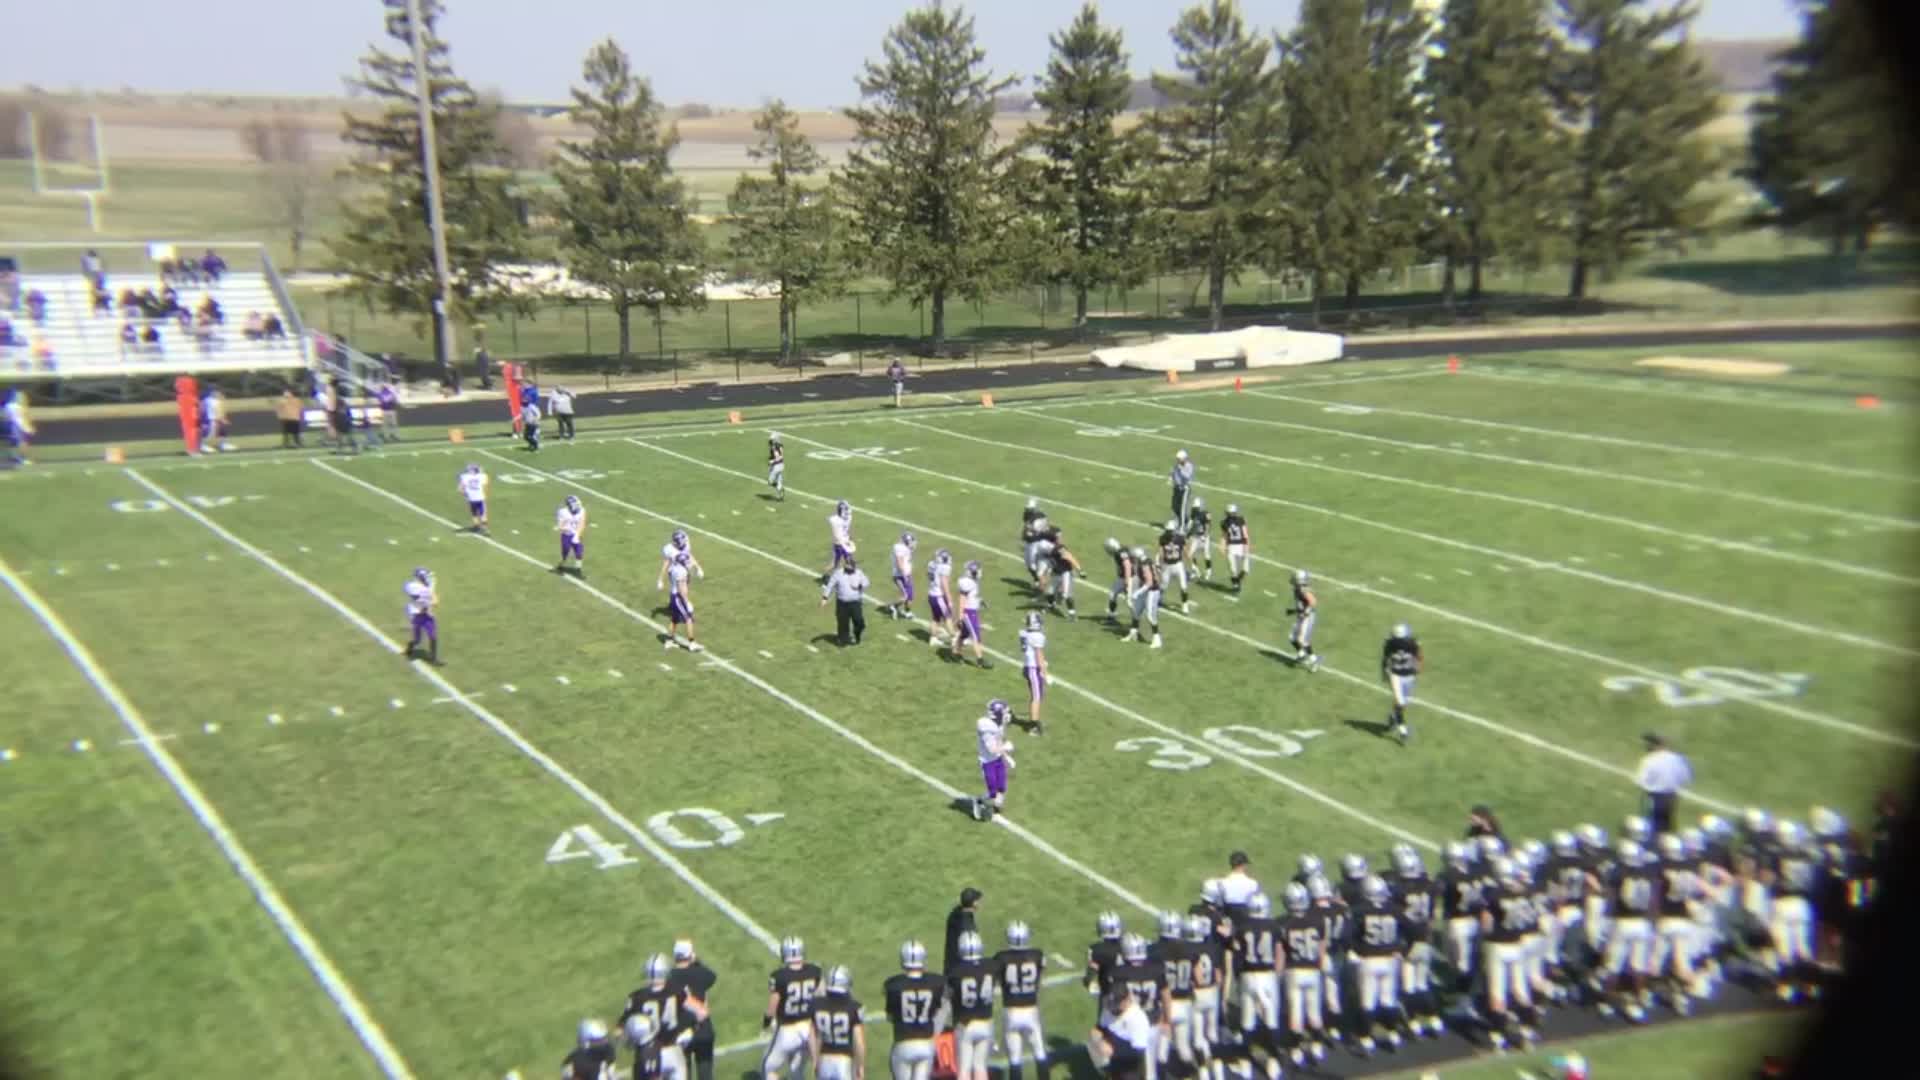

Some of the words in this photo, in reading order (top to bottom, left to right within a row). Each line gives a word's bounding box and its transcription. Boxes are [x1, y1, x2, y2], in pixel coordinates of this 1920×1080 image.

[1600, 666, 1798, 708] 20
[1114, 724, 1304, 771] 30
[545, 807, 745, 870] 40
[1244, 930, 1274, 964] 14
[901, 990, 933, 1024] 67
[961, 974, 994, 1009] 64
